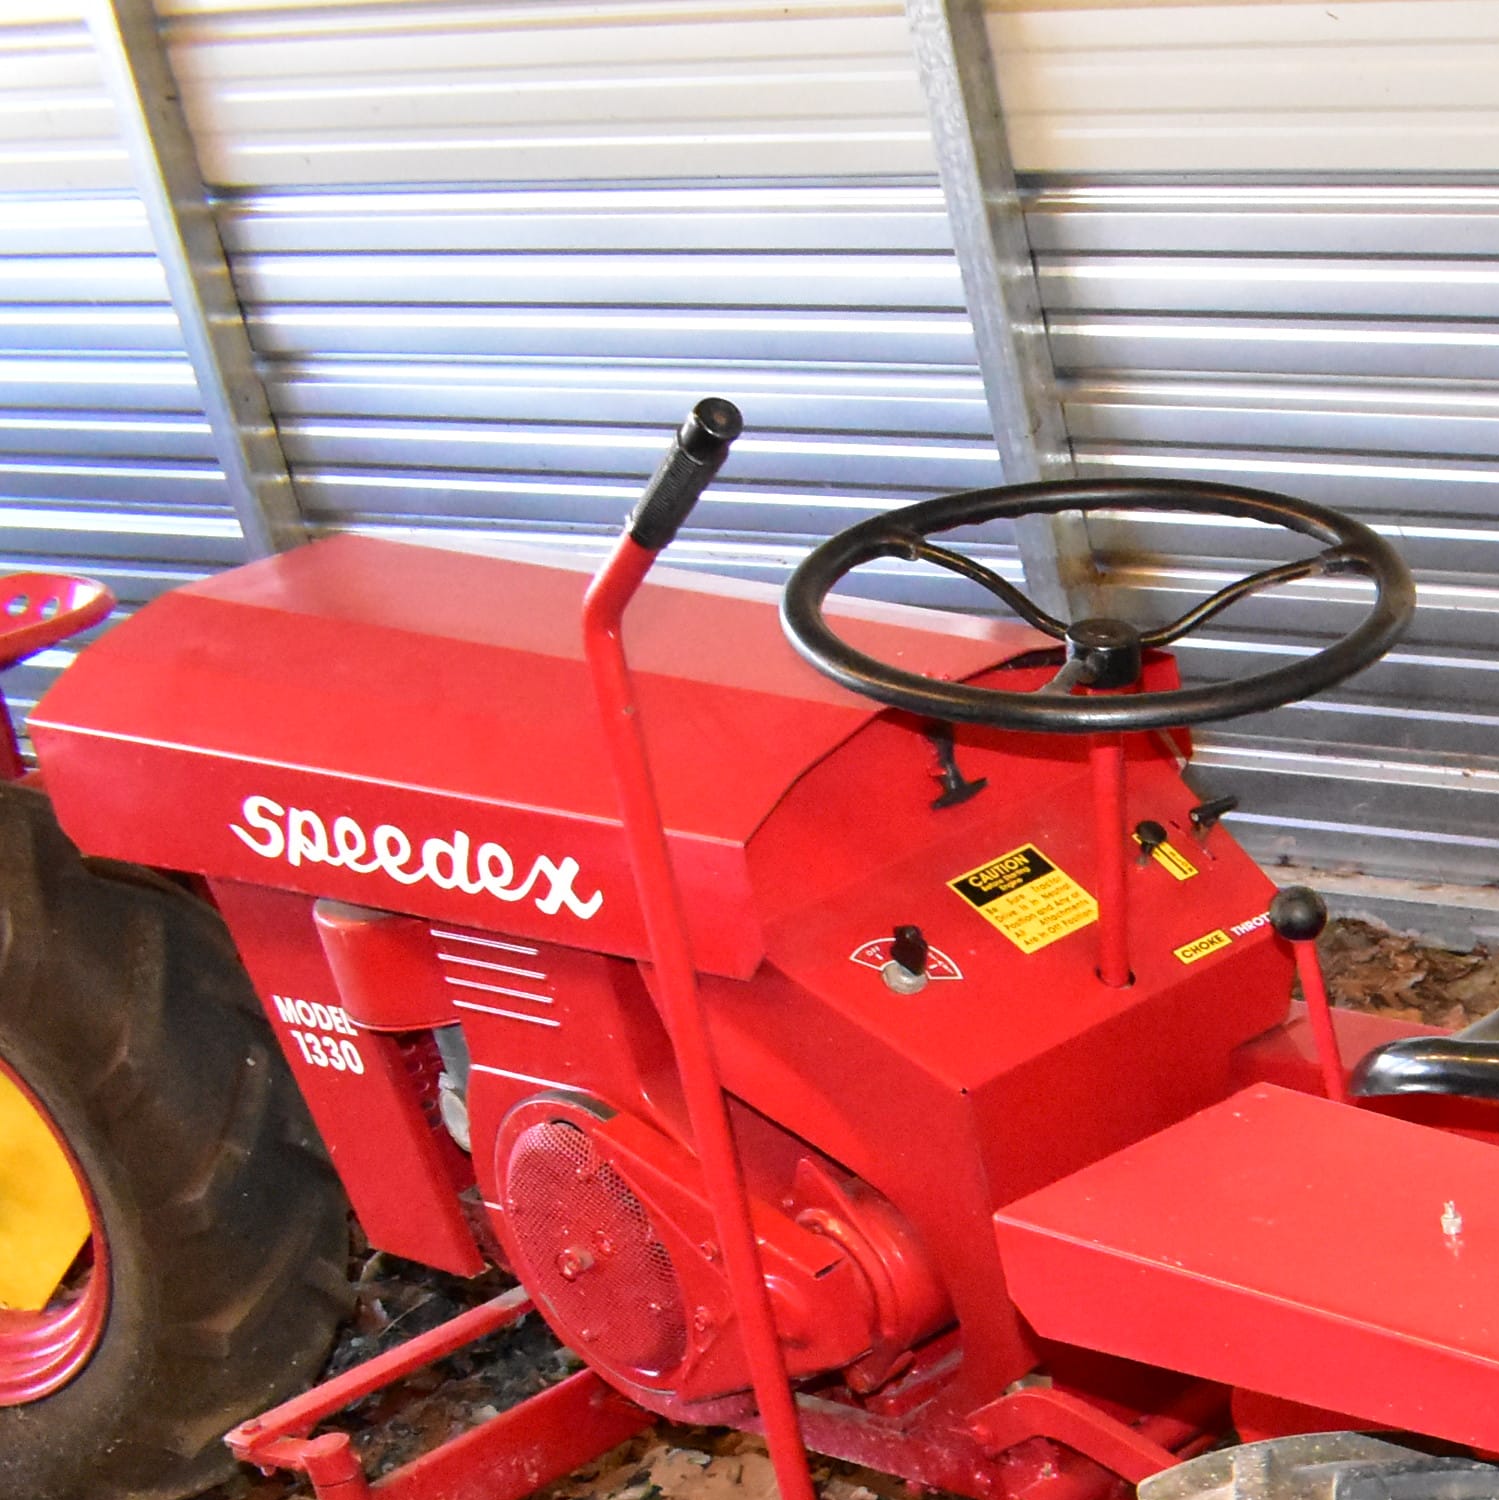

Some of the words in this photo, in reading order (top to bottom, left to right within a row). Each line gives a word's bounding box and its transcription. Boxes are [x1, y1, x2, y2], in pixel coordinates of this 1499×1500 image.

[969, 854, 1029, 887] CAUTION
[1031, 876, 1062, 892] Tractor
[994, 909, 1018, 922] Drive
[1040, 883, 1071, 899] Neutral
[1003, 913, 1037, 930] Position
[1036, 904, 1054, 915] and
[1054, 897, 1071, 906] Any
[1040, 899, 1089, 925] Attachments
[1023, 936, 1040, 946] Are
[1047, 923, 1062, 933] Off
[1230, 911, 1271, 936] THROT
[1181, 934, 1225, 959] CHOKE
[272, 995, 359, 1037] MODEL
[290, 1030, 365, 1075] 1330
